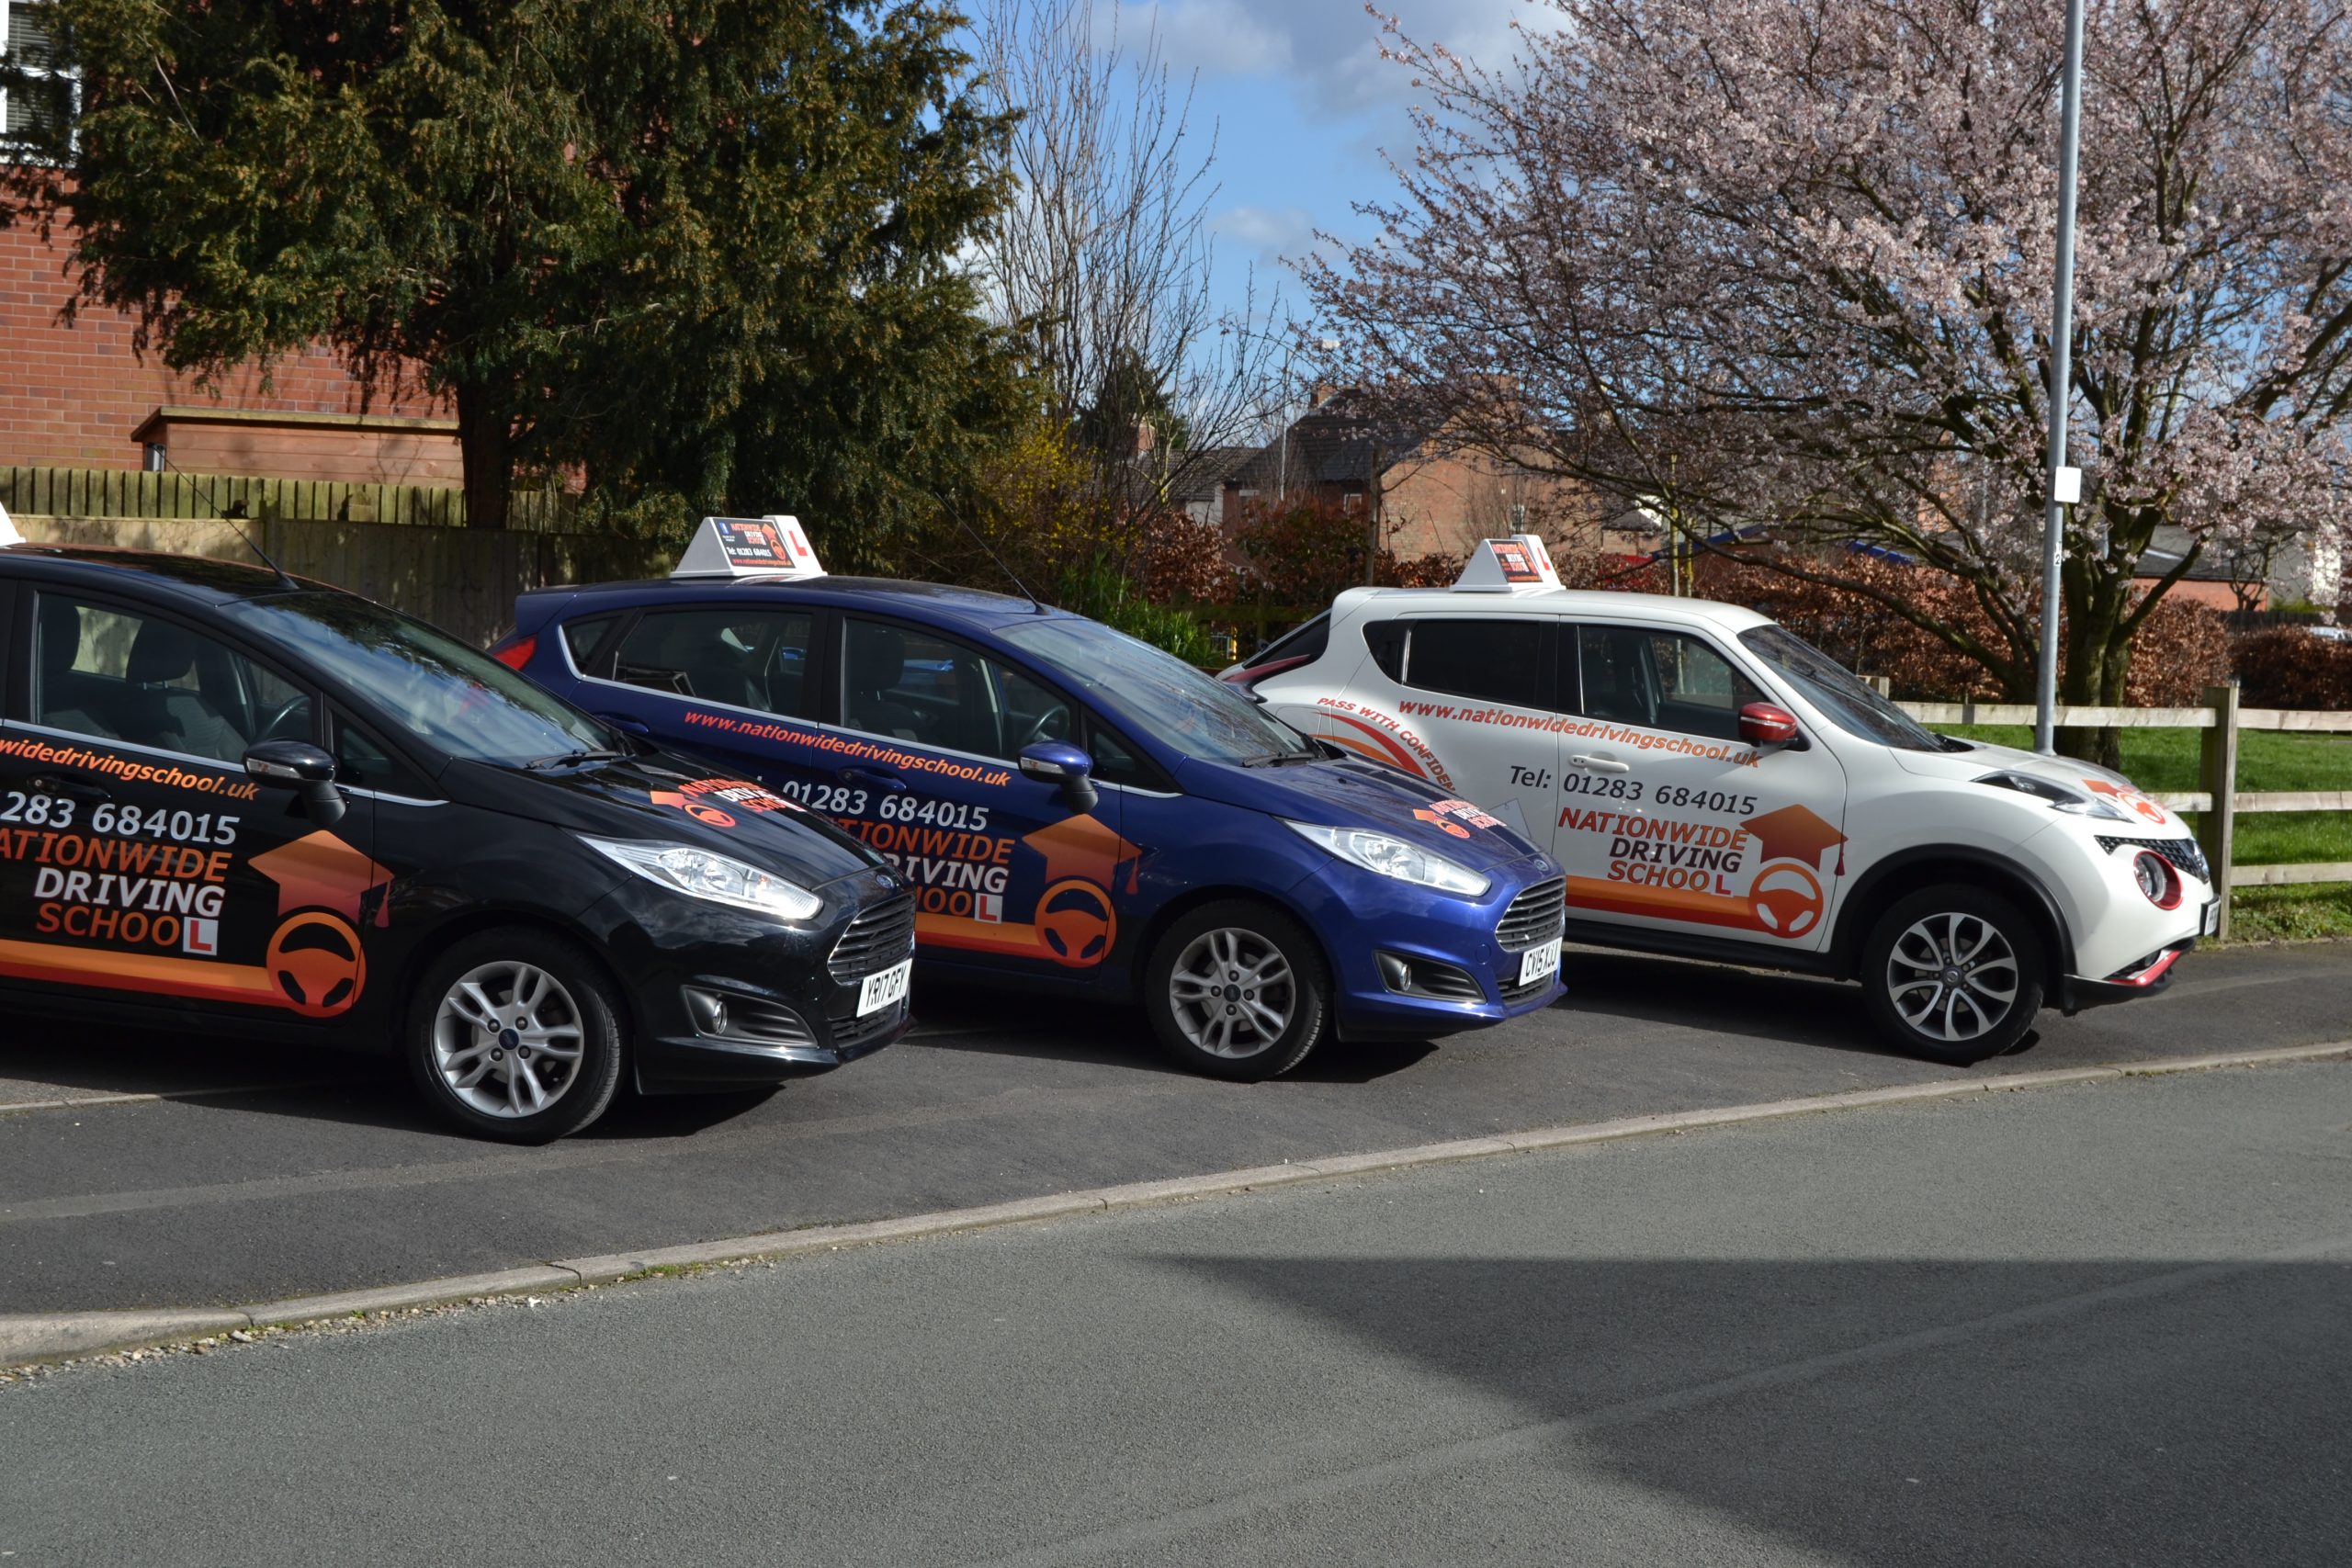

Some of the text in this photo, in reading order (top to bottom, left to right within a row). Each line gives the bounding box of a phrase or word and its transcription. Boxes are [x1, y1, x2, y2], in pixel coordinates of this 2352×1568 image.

[788, 530, 808, 557] L
[684, 710, 1012, 787] www.nationwidedrivingschool.uk
[1317, 697, 1456, 792] PASS WITH CONFIDEN
[1399, 699, 1762, 769] www.nationwidedrivingschool.uk
[0, 739, 259, 801] widedrivingschool.uk
[1510, 765, 1758, 816] Tel: 01283 684015
[92, 803, 240, 845] 684015
[879, 795, 989, 831] 684015
[1558, 807, 1750, 851] NATIONWIDE
[833, 818, 1015, 864] TIONWIDE
[1610, 838, 1742, 873] DRIVING
[34, 867, 226, 918] DRIVING
[1607, 860, 1732, 896] SCHOOL
[36, 902, 219, 955] SCHOOL
[1525, 948, 1544, 977] CV15
[865, 964, 908, 1009] YR17 GFY
